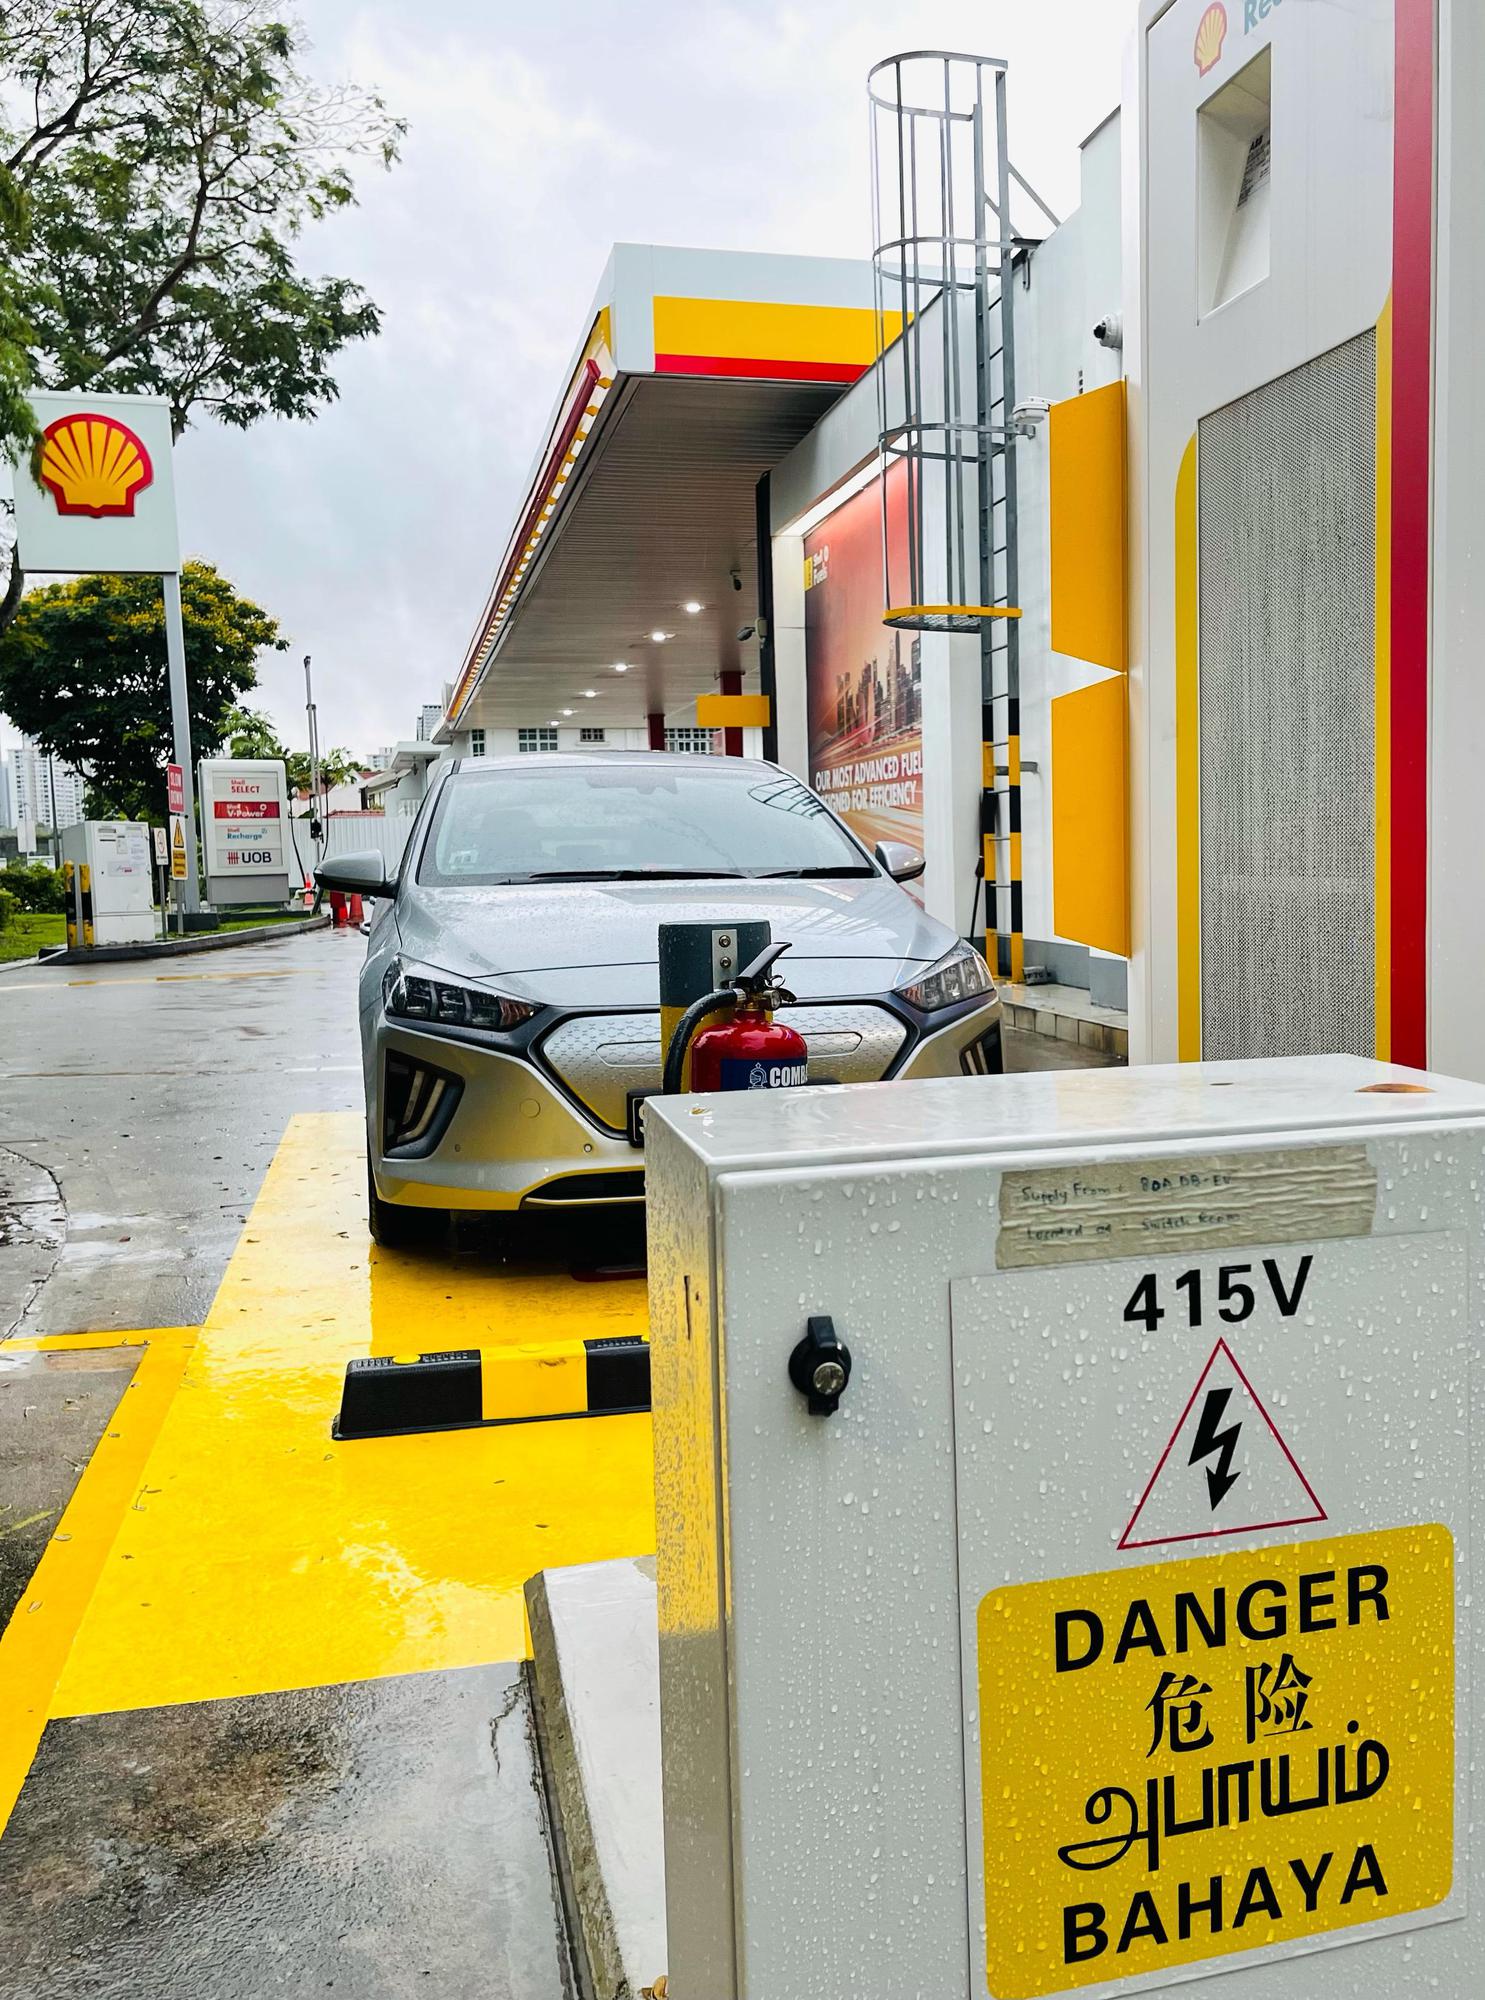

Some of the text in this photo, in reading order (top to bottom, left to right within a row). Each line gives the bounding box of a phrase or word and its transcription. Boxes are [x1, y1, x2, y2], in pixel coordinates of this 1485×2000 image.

[231, 785, 260, 794] SELECT
[815, 769, 831, 792] OUR
[832, 764, 853, 788] MOST
[853, 755, 899, 785] ADVANCED
[851, 788, 868, 811] FOR
[869, 780, 917, 808] EFFICIENCY
[227, 832, 263, 840] Recharge
[241, 851, 272, 863] UOB
[1022, 1186, 1067, 1204] Supply
[1123, 1255, 1314, 1332] 415V
[1054, 1563, 1391, 1674] DANGER
[1144, 1653, 1315, 1759] 危险
[1057, 1719, 1391, 1873] அபாயம்
[1062, 1843, 1389, 1965] BAHAYA
